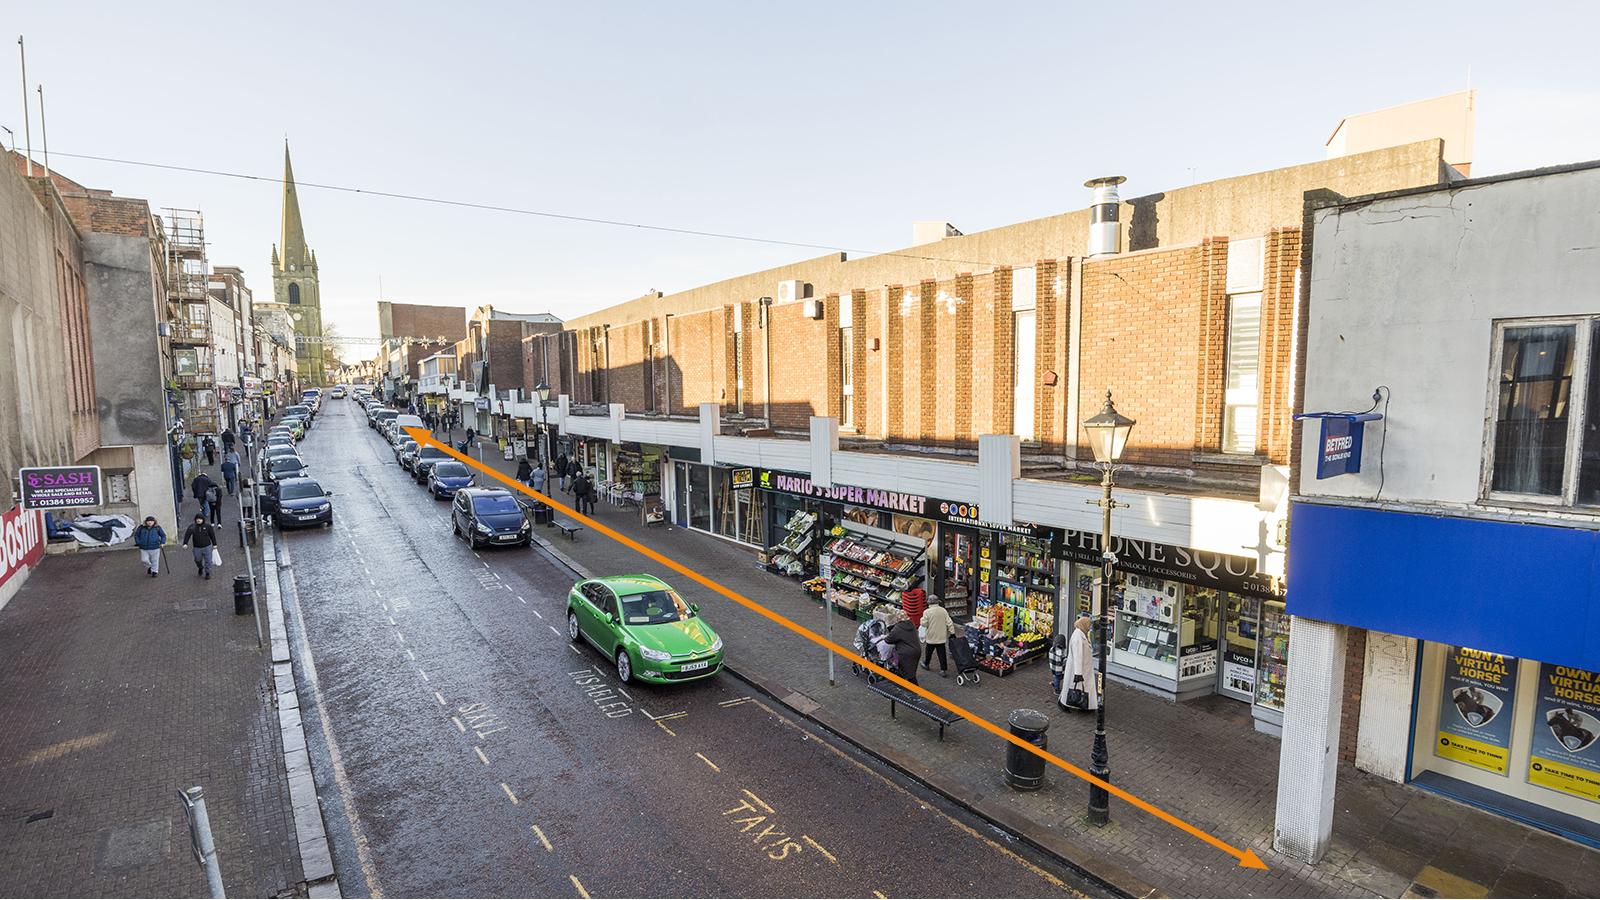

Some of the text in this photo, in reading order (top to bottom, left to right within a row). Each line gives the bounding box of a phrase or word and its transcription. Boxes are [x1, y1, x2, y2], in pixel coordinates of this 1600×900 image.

[1326, 436, 1352, 453] BETFRED
[44, 472, 93, 485] SASH
[65, 497, 94, 505] 910952
[825, 485, 864, 504] SUPER
[866, 488, 926, 514] MARKET
[948, 515, 1031, 535] INTERNATIONAL SUPER MARKET
[1062, 529, 1271, 580] PHONE SQU
[1121, 562, 1147, 571] UNLOCK
[1152, 567, 1197, 580] ACCESSORIES
[1233, 653, 1249, 663] Lyca
[1461, 647, 1504, 664] OWN A
[1455, 655, 1509, 676] VIRTUAL
[1556, 666, 1591, 681] OWN
[1460, 666, 1501, 684] HORSE
[1549, 674, 1600, 694] VIRTUA
[568, 670, 633, 718] DISABLED
[1451, 742, 1464, 750] TAKE
[1465, 745, 1478, 753] TIME
[1544, 767, 1559, 775] TAKE
[1585, 778, 1600, 787] THIN
[722, 799, 802, 860] TAXIS
